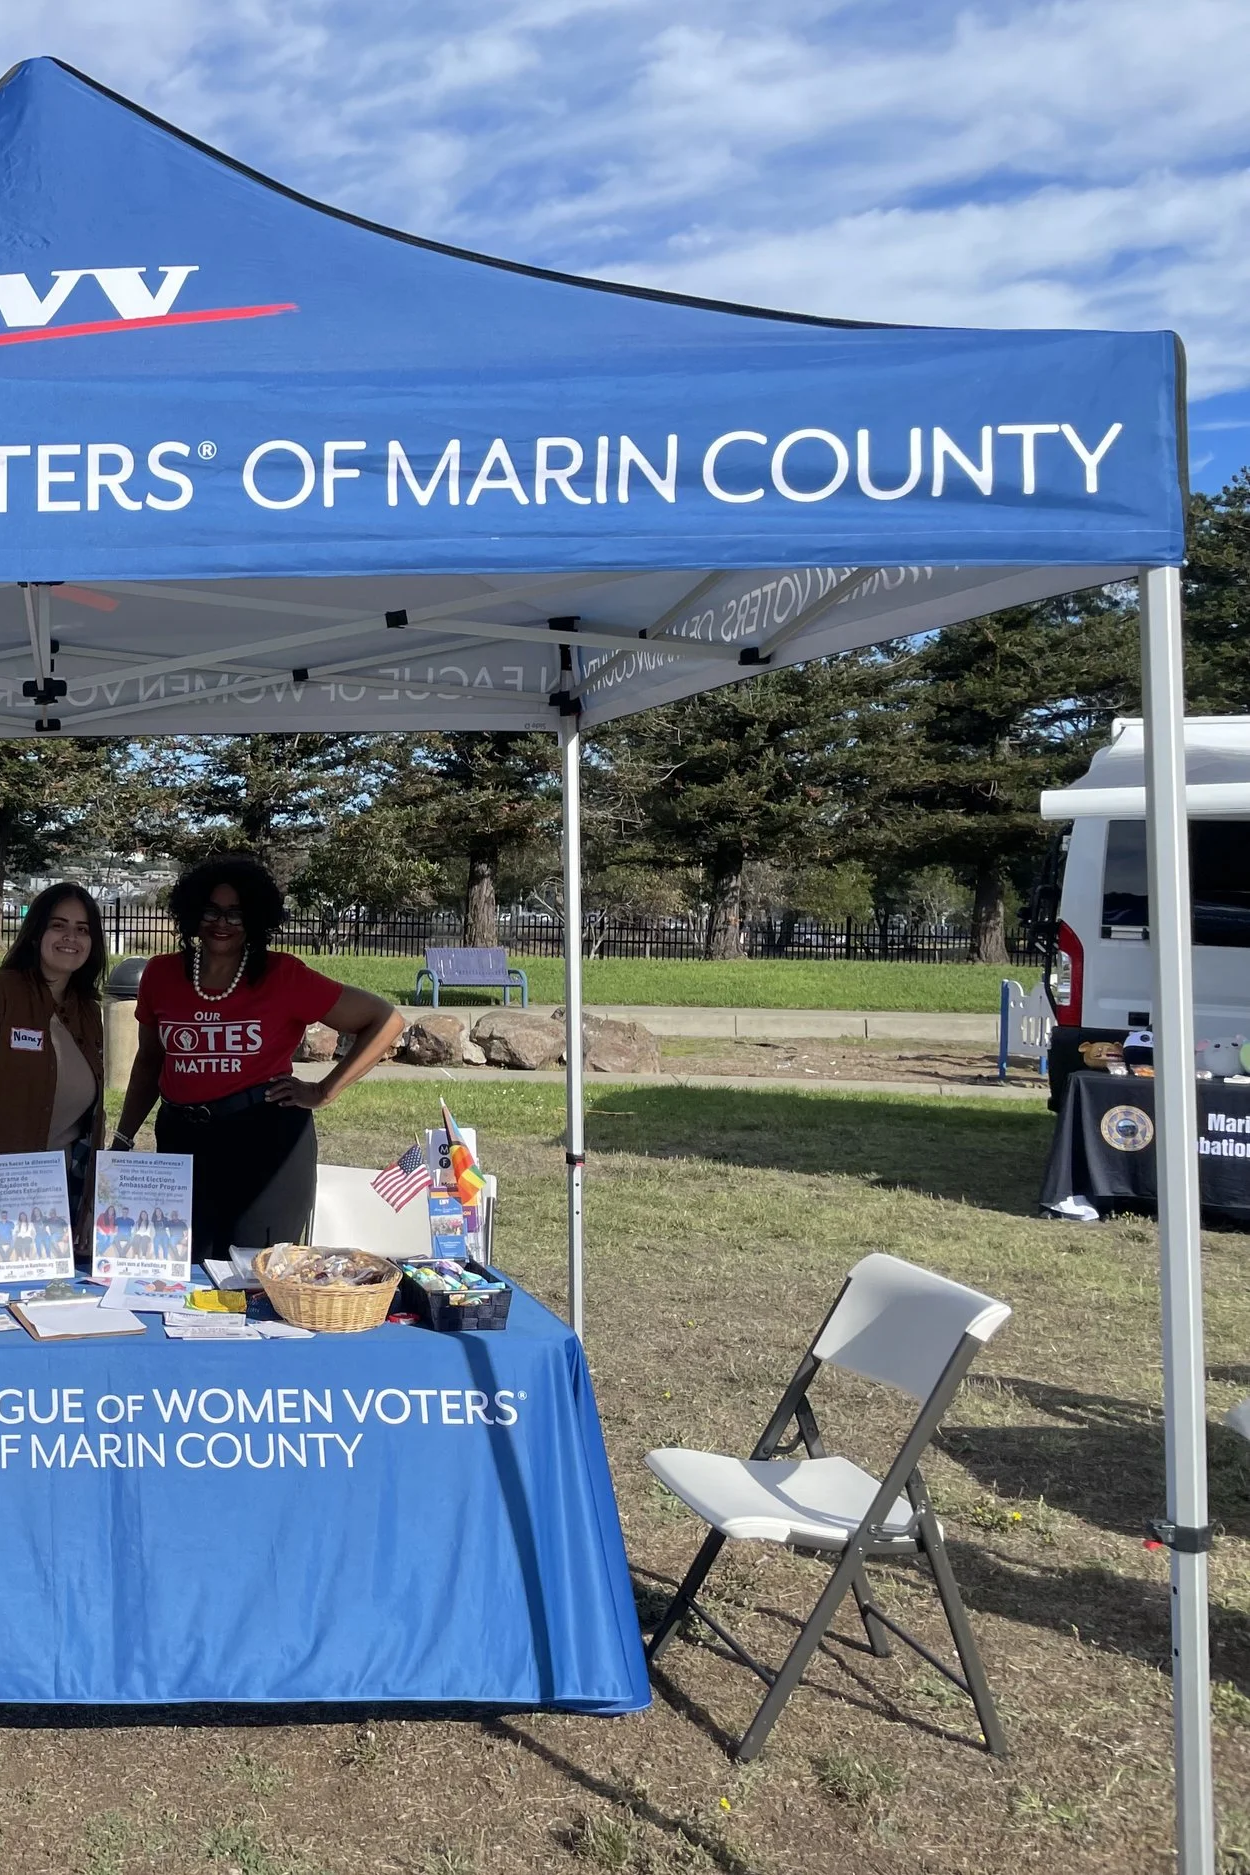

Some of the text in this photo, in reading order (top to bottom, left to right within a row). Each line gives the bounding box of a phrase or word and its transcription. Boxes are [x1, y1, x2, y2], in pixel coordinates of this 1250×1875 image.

[242, 439, 367, 510] OF
[386, 433, 677, 507] MARIN
[703, 422, 1123, 503] COUNTY
[193, 1011, 221, 1021] OUR
[13, 1030, 42, 1046] Nancy
[158, 1023, 263, 1052] VOTES
[174, 1058, 242, 1073] MATTER
[1195, 1136, 1250, 1158] batio
[118, 1181, 188, 1192] Ambassador Program
[119, 1174, 175, 1183] Student Elections
[96, 1394, 145, 1424] OF
[152, 1388, 333, 1424] WOMEN
[31, 1432, 165, 1469] MARIN
[175, 1431, 364, 1469] COUNTY
